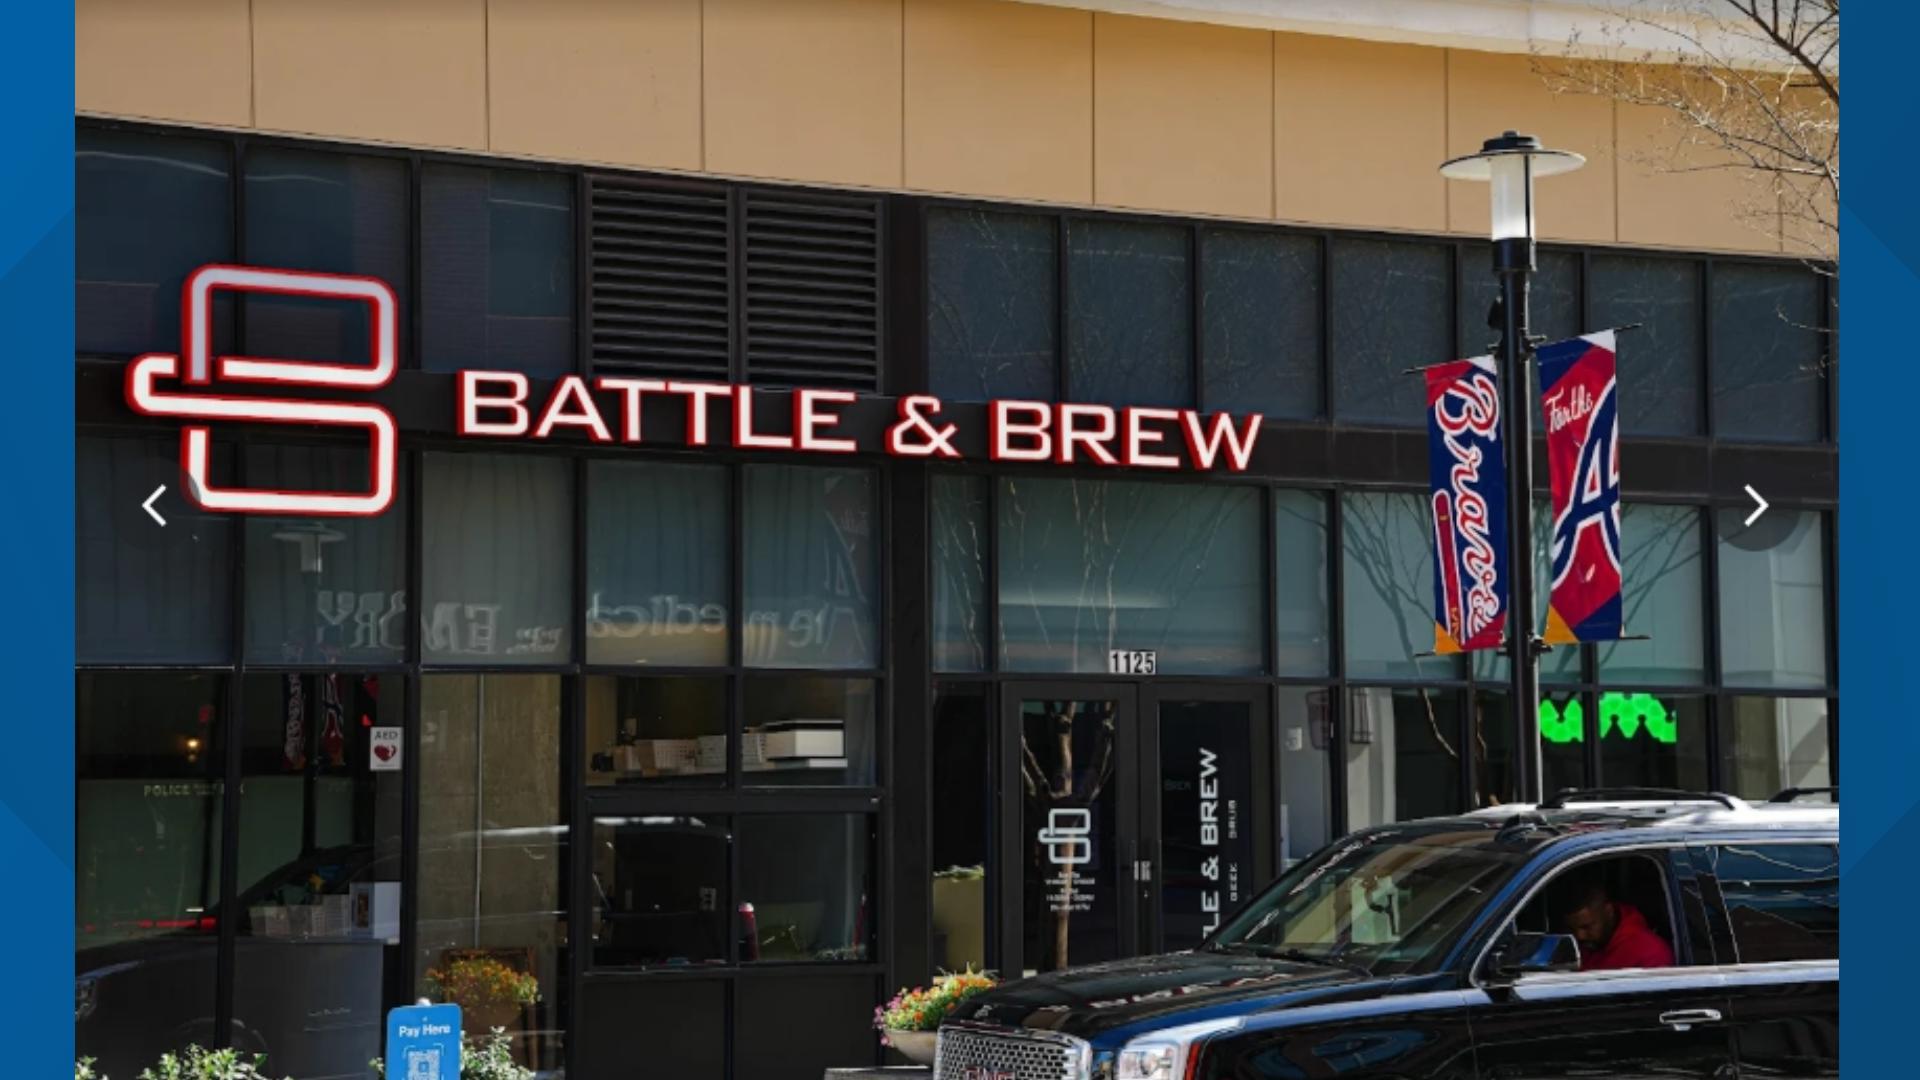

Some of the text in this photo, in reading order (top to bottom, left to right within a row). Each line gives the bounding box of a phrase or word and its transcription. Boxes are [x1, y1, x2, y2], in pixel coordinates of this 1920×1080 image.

[457, 369, 1263, 472] BATTLE & BREW
[1111, 651, 1155, 674] 1125
[374, 730, 399, 741] AED
[1199, 747, 1219, 845] BREW
[1200, 855, 1220, 881] &
[399, 1023, 451, 1038] Pay Here
